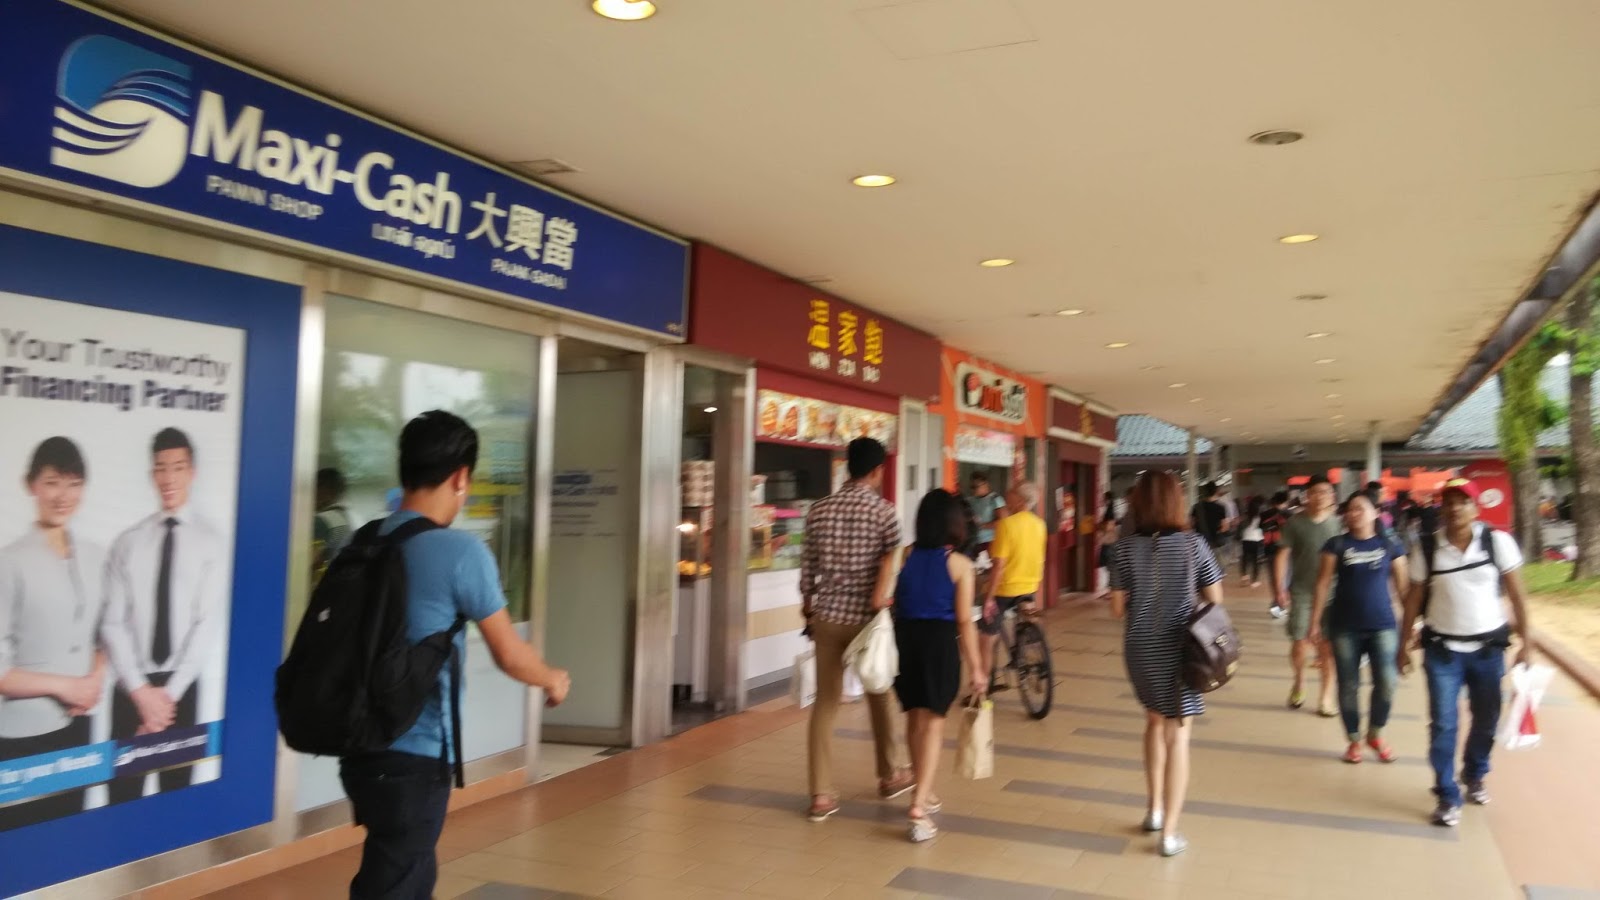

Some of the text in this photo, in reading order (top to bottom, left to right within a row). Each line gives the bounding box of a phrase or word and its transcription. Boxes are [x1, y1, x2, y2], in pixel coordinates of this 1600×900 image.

[190, 90, 461, 234] Maxi-Cash
[206, 174, 324, 220] PAWN SHOP
[465, 192, 578, 270] 大興當
[1, 328, 231, 386] Your Trustworthy
[0, 366, 227, 413] Financing Partner
